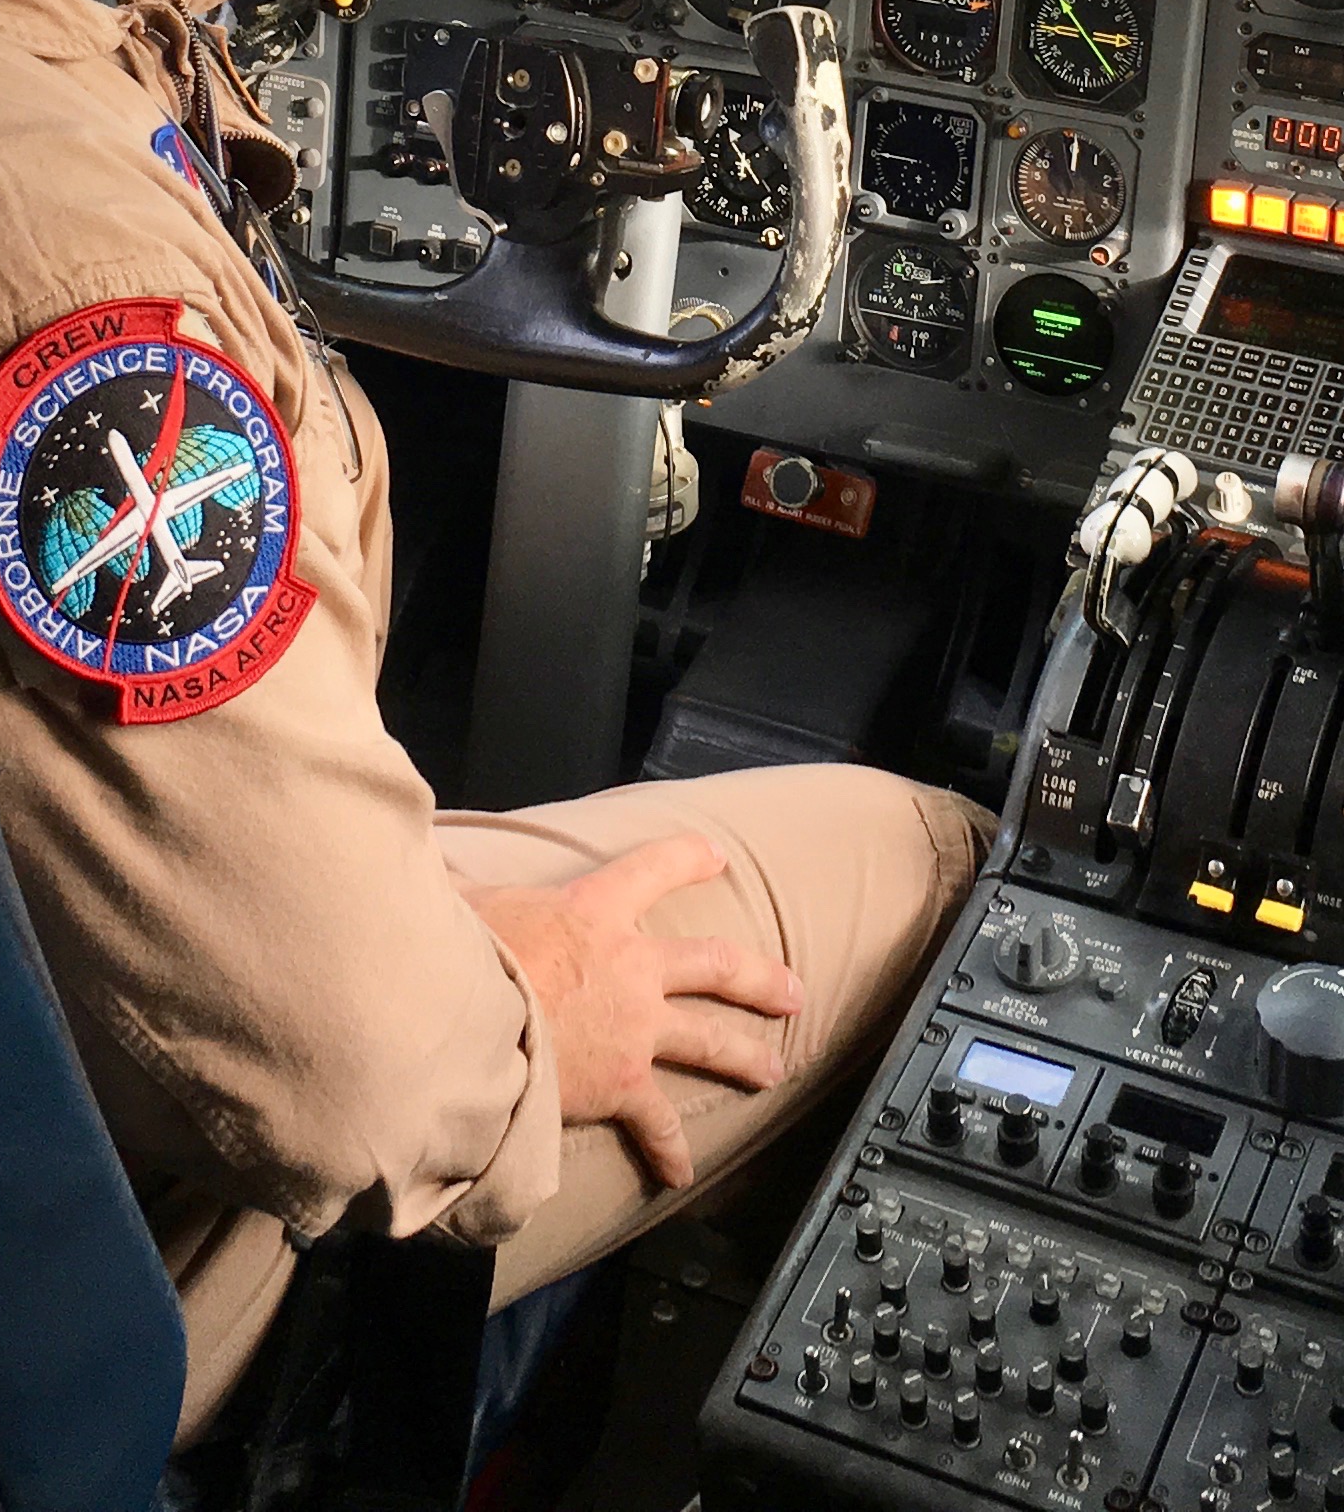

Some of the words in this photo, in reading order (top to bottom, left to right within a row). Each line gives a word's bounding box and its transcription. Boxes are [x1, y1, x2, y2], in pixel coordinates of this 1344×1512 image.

[337, 7, 356, 19] REL
[269, 74, 305, 88] AIRSPEEDS
[1273, 117, 1340, 152] 000
[1235, 140, 1260, 151] SPEED
[910, 292, 924, 301] ALT
[13, 313, 125, 388] CREW
[16, 346, 168, 448] SCIENCE
[186, 355, 286, 533] PROGRAM
[144, 585, 270, 671] NASA
[134, 667, 228, 709] NASA
[237, 591, 299, 672] AFRC
[1294, 666, 1319, 680] FUEL
[1042, 772, 1077, 793] LONG
[1260, 779, 1284, 794] FUEL
[1041, 790, 1073, 810] TRIM
[1257, 789, 1277, 801] OFF
[982, 1000, 1049, 1028] SELECTOR
[1000, 995, 1039, 1015] PITCH
[1124, 1046, 1159, 1067] VERT
